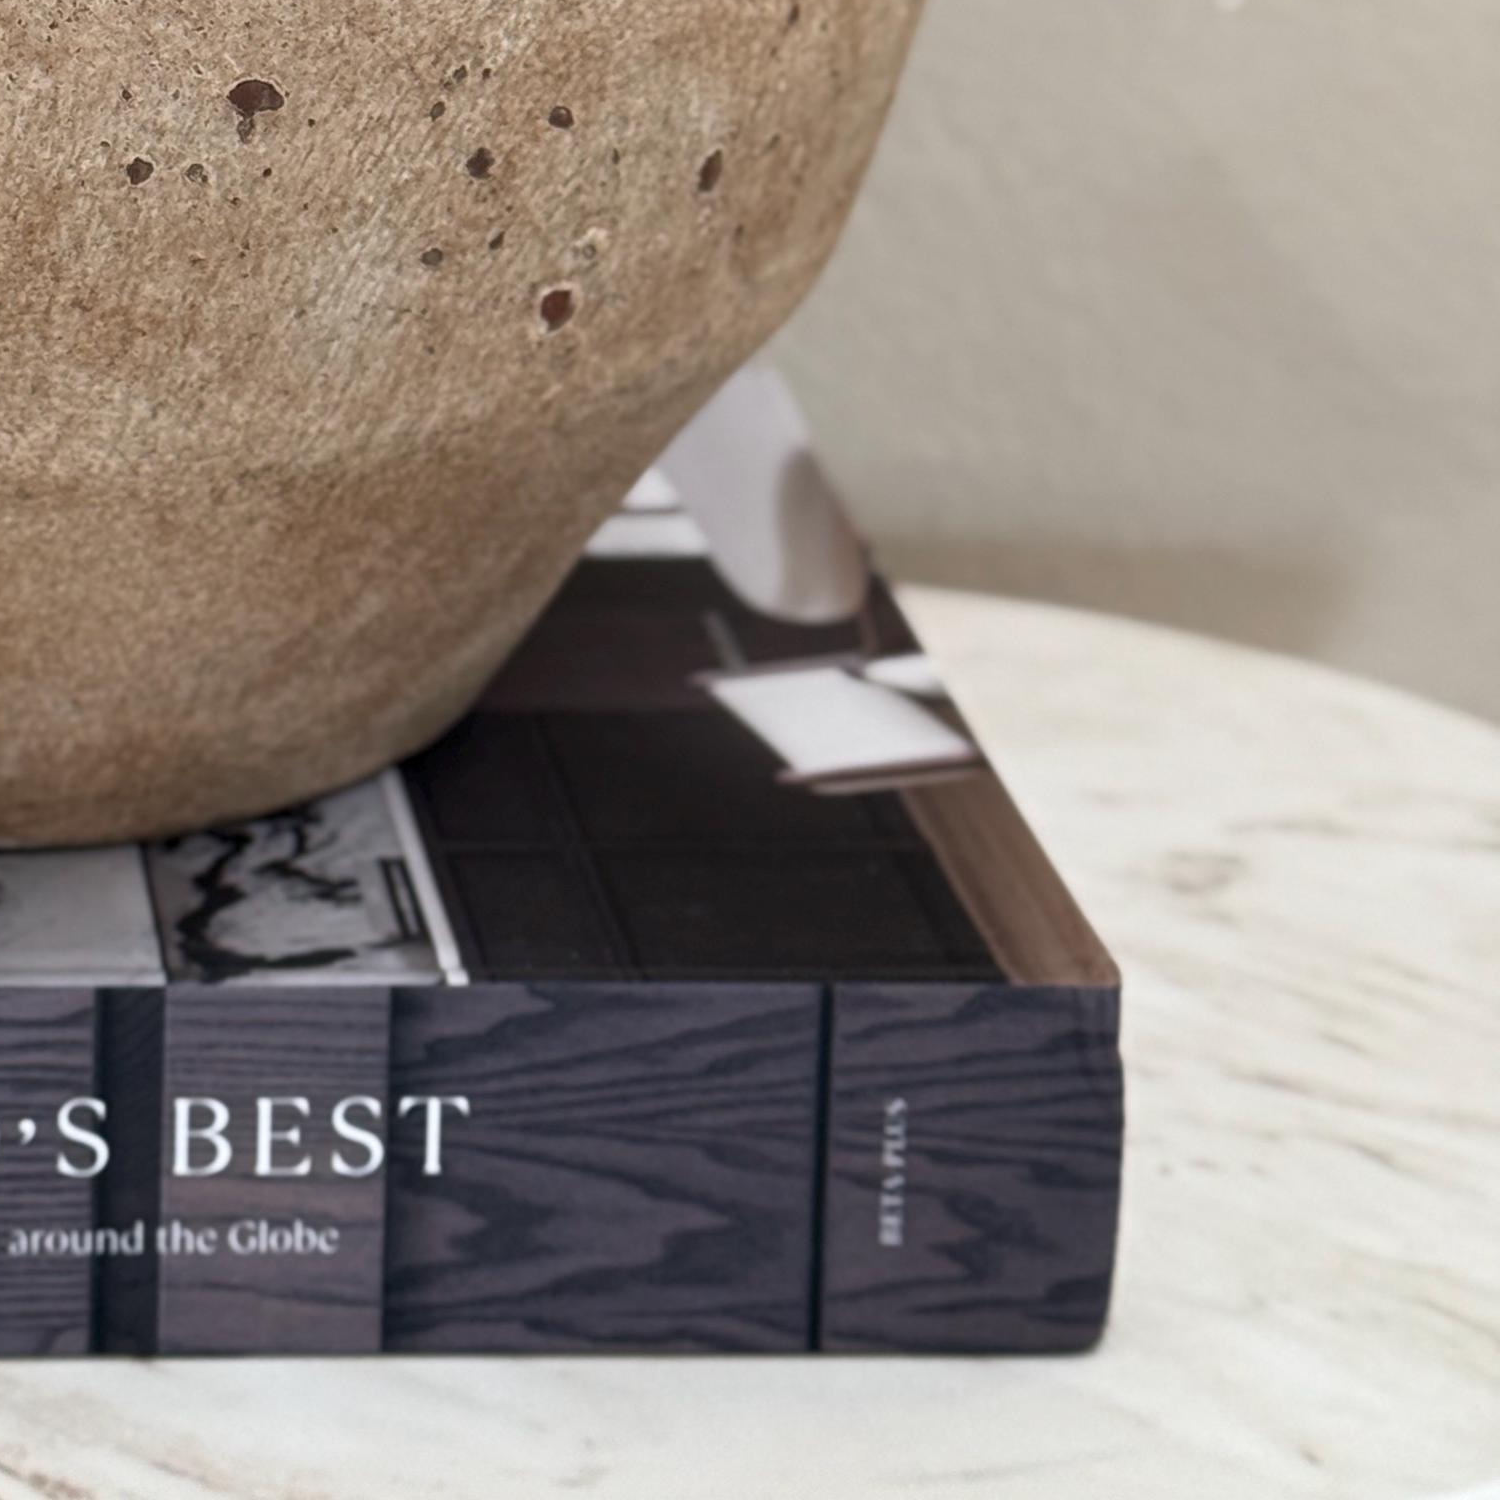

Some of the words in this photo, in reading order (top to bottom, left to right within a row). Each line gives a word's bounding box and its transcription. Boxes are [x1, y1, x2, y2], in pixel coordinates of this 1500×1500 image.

[171, 1095, 471, 1178] BEST
[8, 1219, 145, 1255] around
[156, 1219, 218, 1255] the
[227, 1219, 341, 1255] Globe
